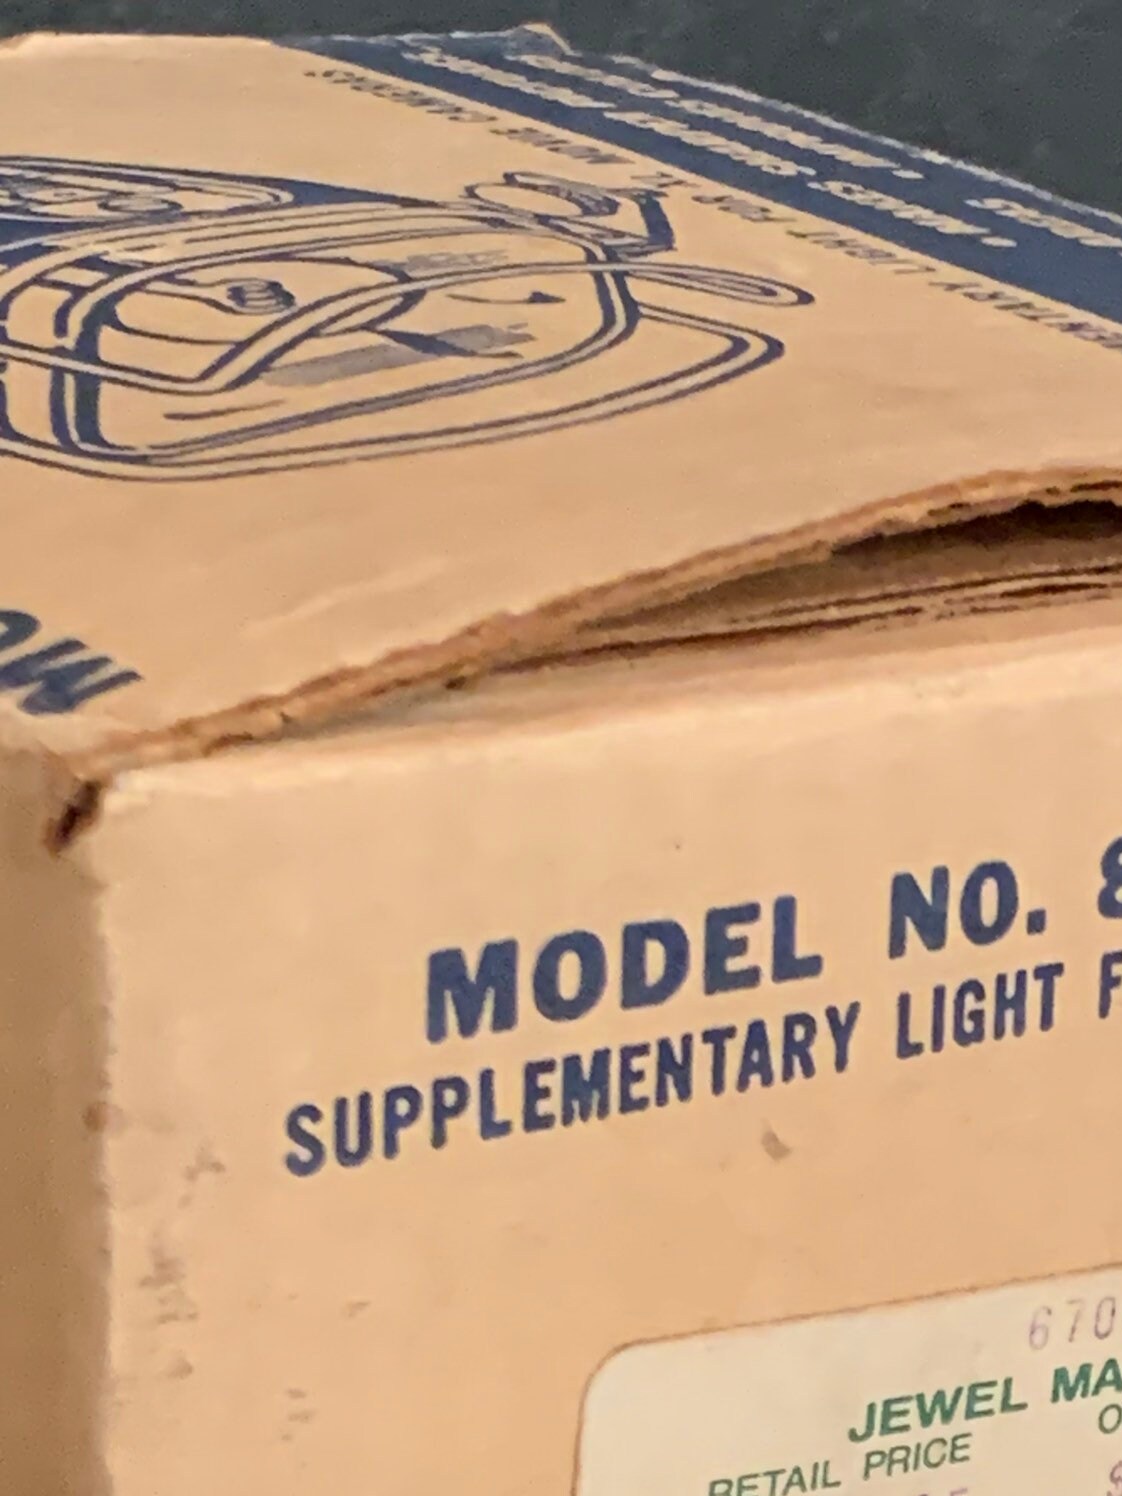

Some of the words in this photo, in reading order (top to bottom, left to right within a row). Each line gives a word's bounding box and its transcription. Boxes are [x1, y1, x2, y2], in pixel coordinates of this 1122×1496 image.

[427, 895, 822, 1043] MODEL
[888, 860, 1046, 958] NO.
[284, 1001, 860, 1177] SUPPLEMENTARY
[896, 963, 1063, 1058] LIGHT
[847, 1377, 1029, 1443] JEWEL
[863, 1433, 973, 1481] PRICE
